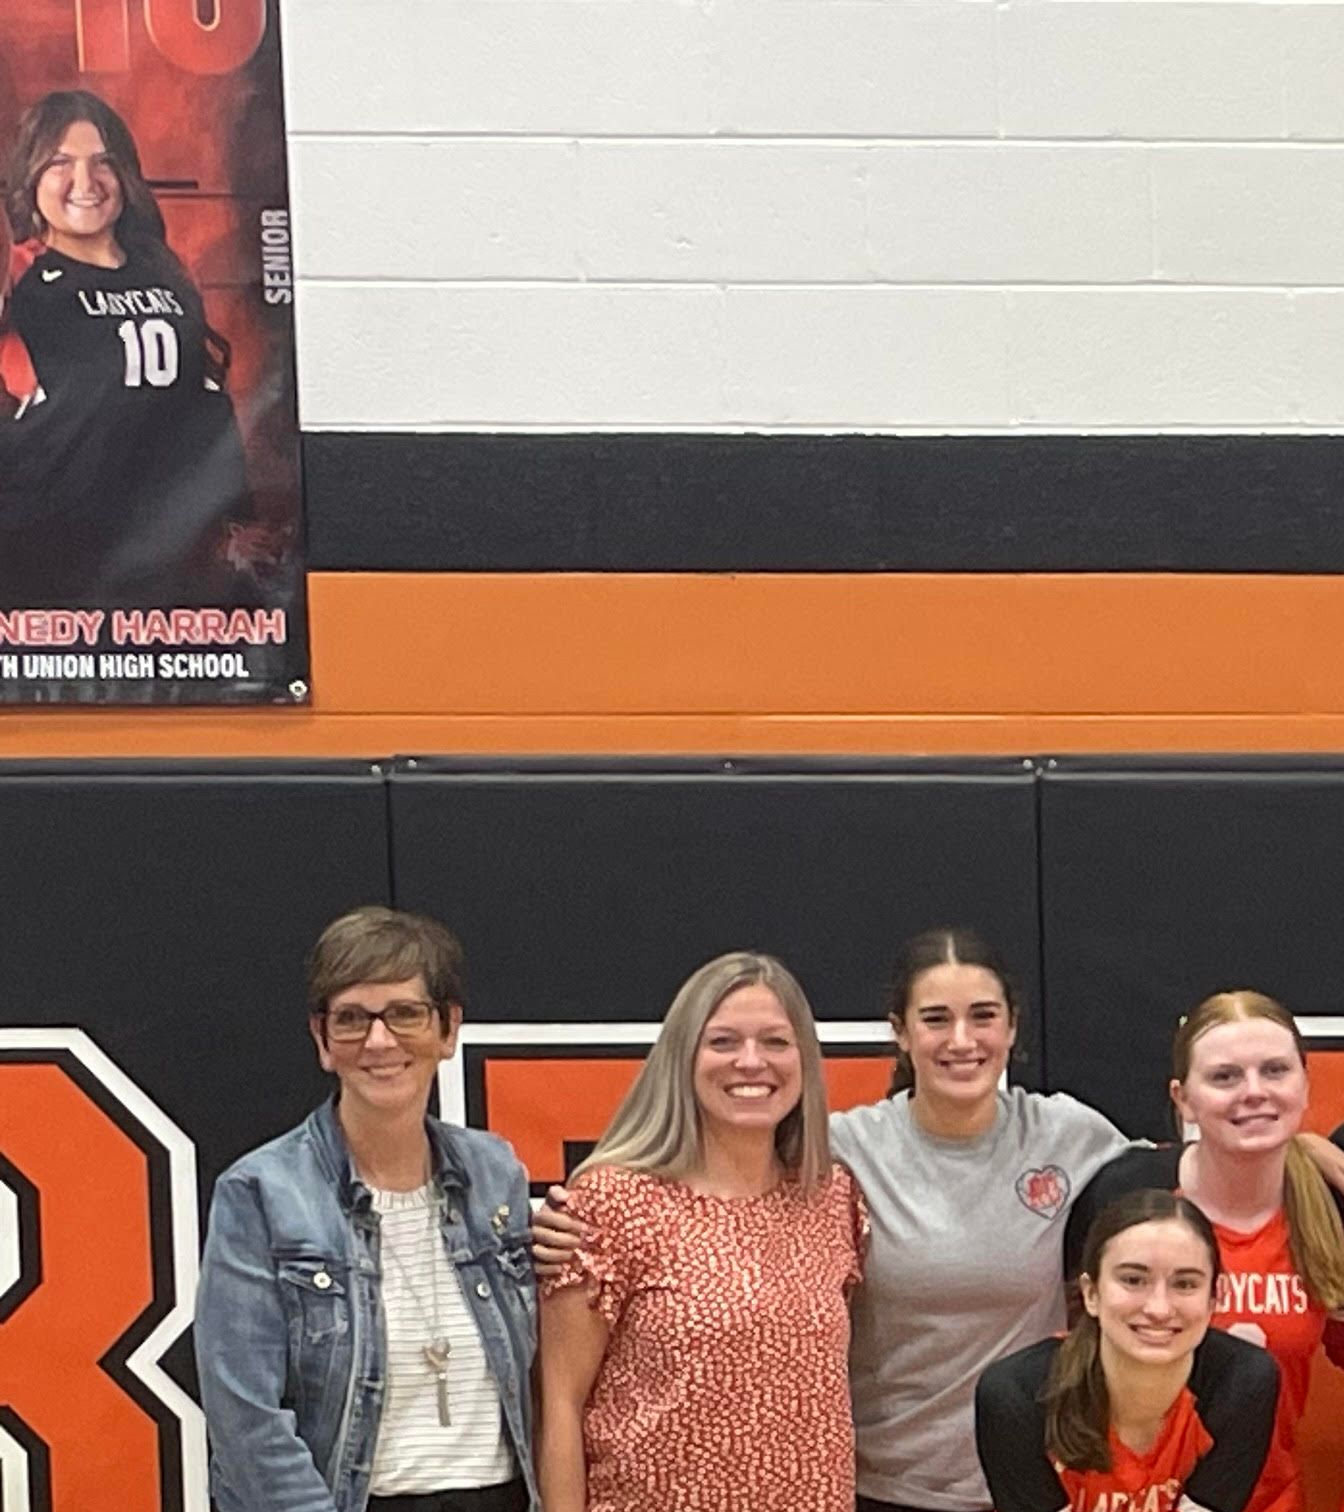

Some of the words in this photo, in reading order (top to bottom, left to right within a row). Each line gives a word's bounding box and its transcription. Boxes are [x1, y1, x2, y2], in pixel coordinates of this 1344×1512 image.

[260, 209, 292, 304] SENIOR
[78, 287, 184, 316] LADYCATS
[118, 318, 178, 387] 10
[111, 608, 286, 645] HARRAH
[23, 654, 95, 678] UNION
[100, 654, 154, 678] HIGH
[159, 653, 249, 678] SCHOOL
[1215, 1272, 1308, 1315] DYCATS
